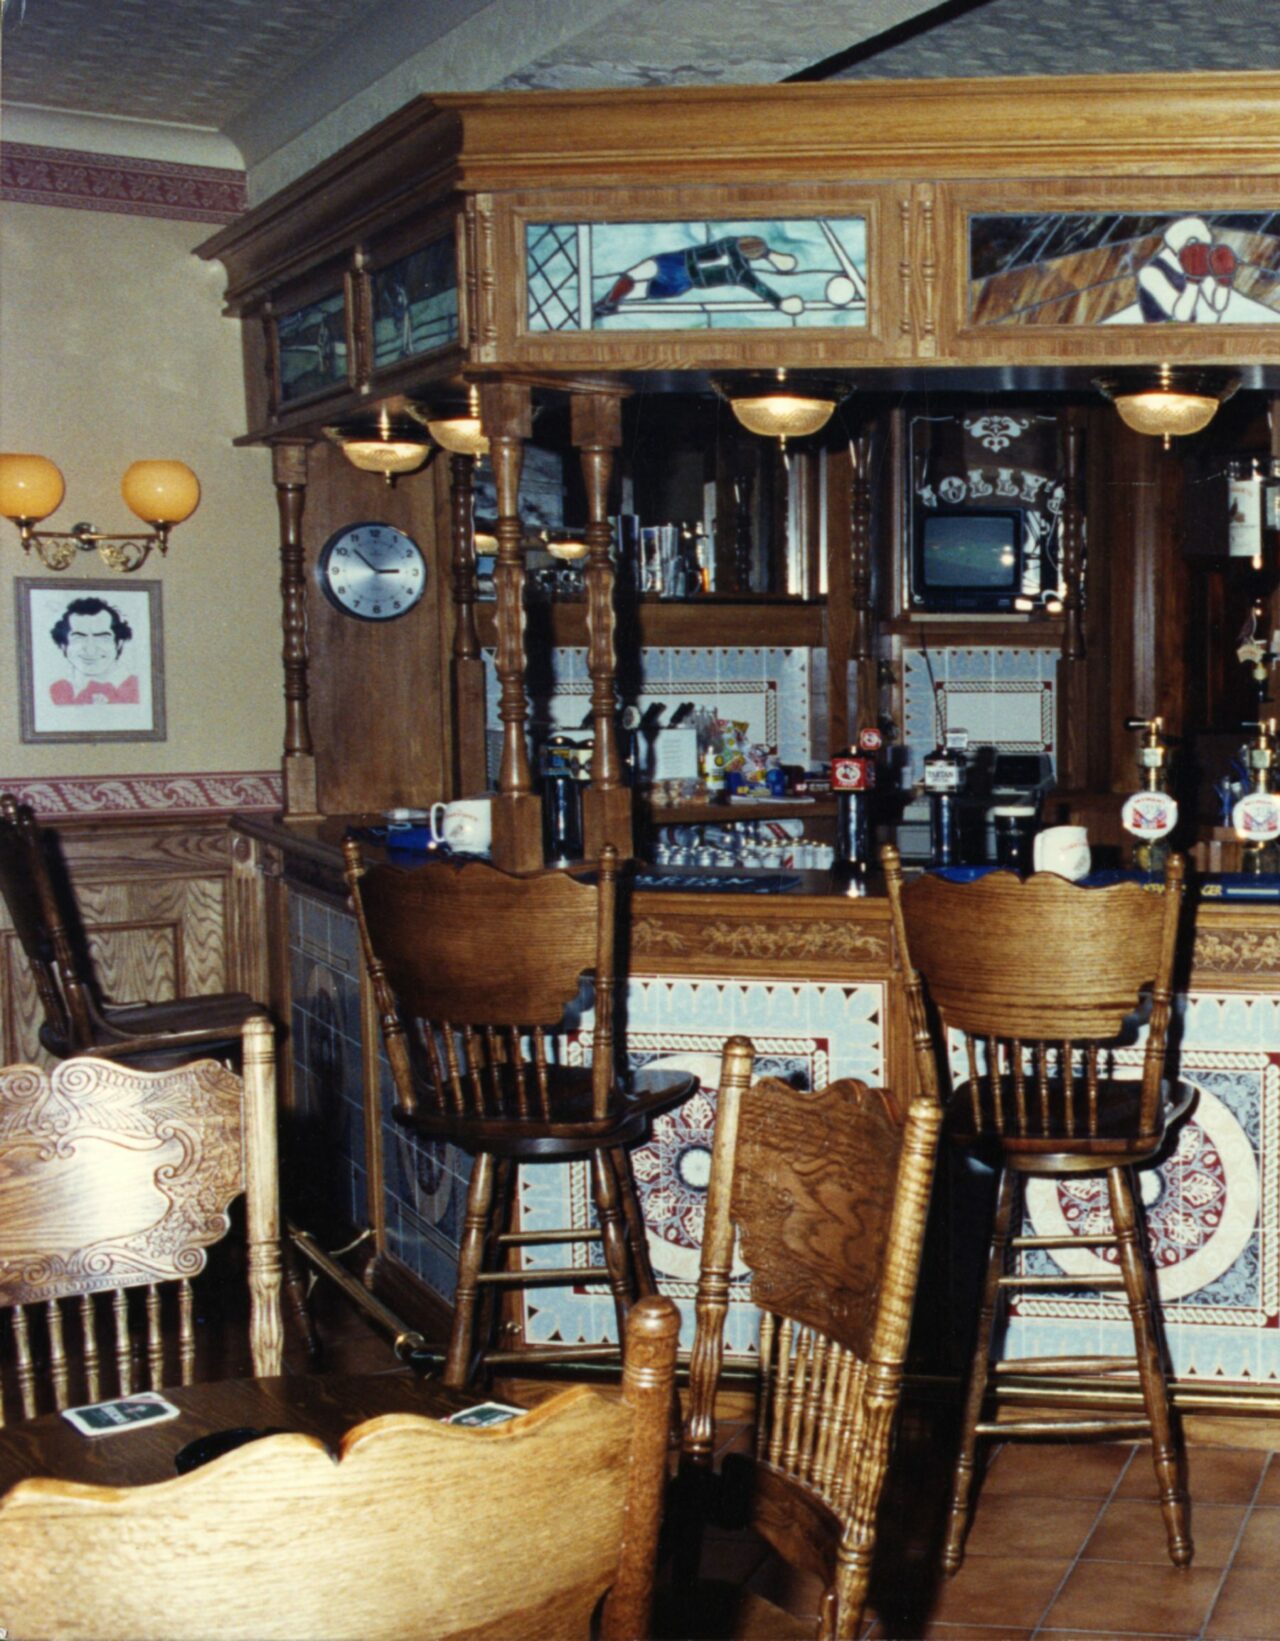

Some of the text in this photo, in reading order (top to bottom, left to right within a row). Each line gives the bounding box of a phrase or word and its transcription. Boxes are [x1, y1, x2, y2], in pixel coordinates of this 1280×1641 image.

[369, 528, 381, 538] 12
[335, 547, 348, 556] 10
[405, 548, 414, 559] 2
[332, 566, 340, 576] 9
[406, 588, 413, 596] 4
[372, 605, 381, 615] 6
